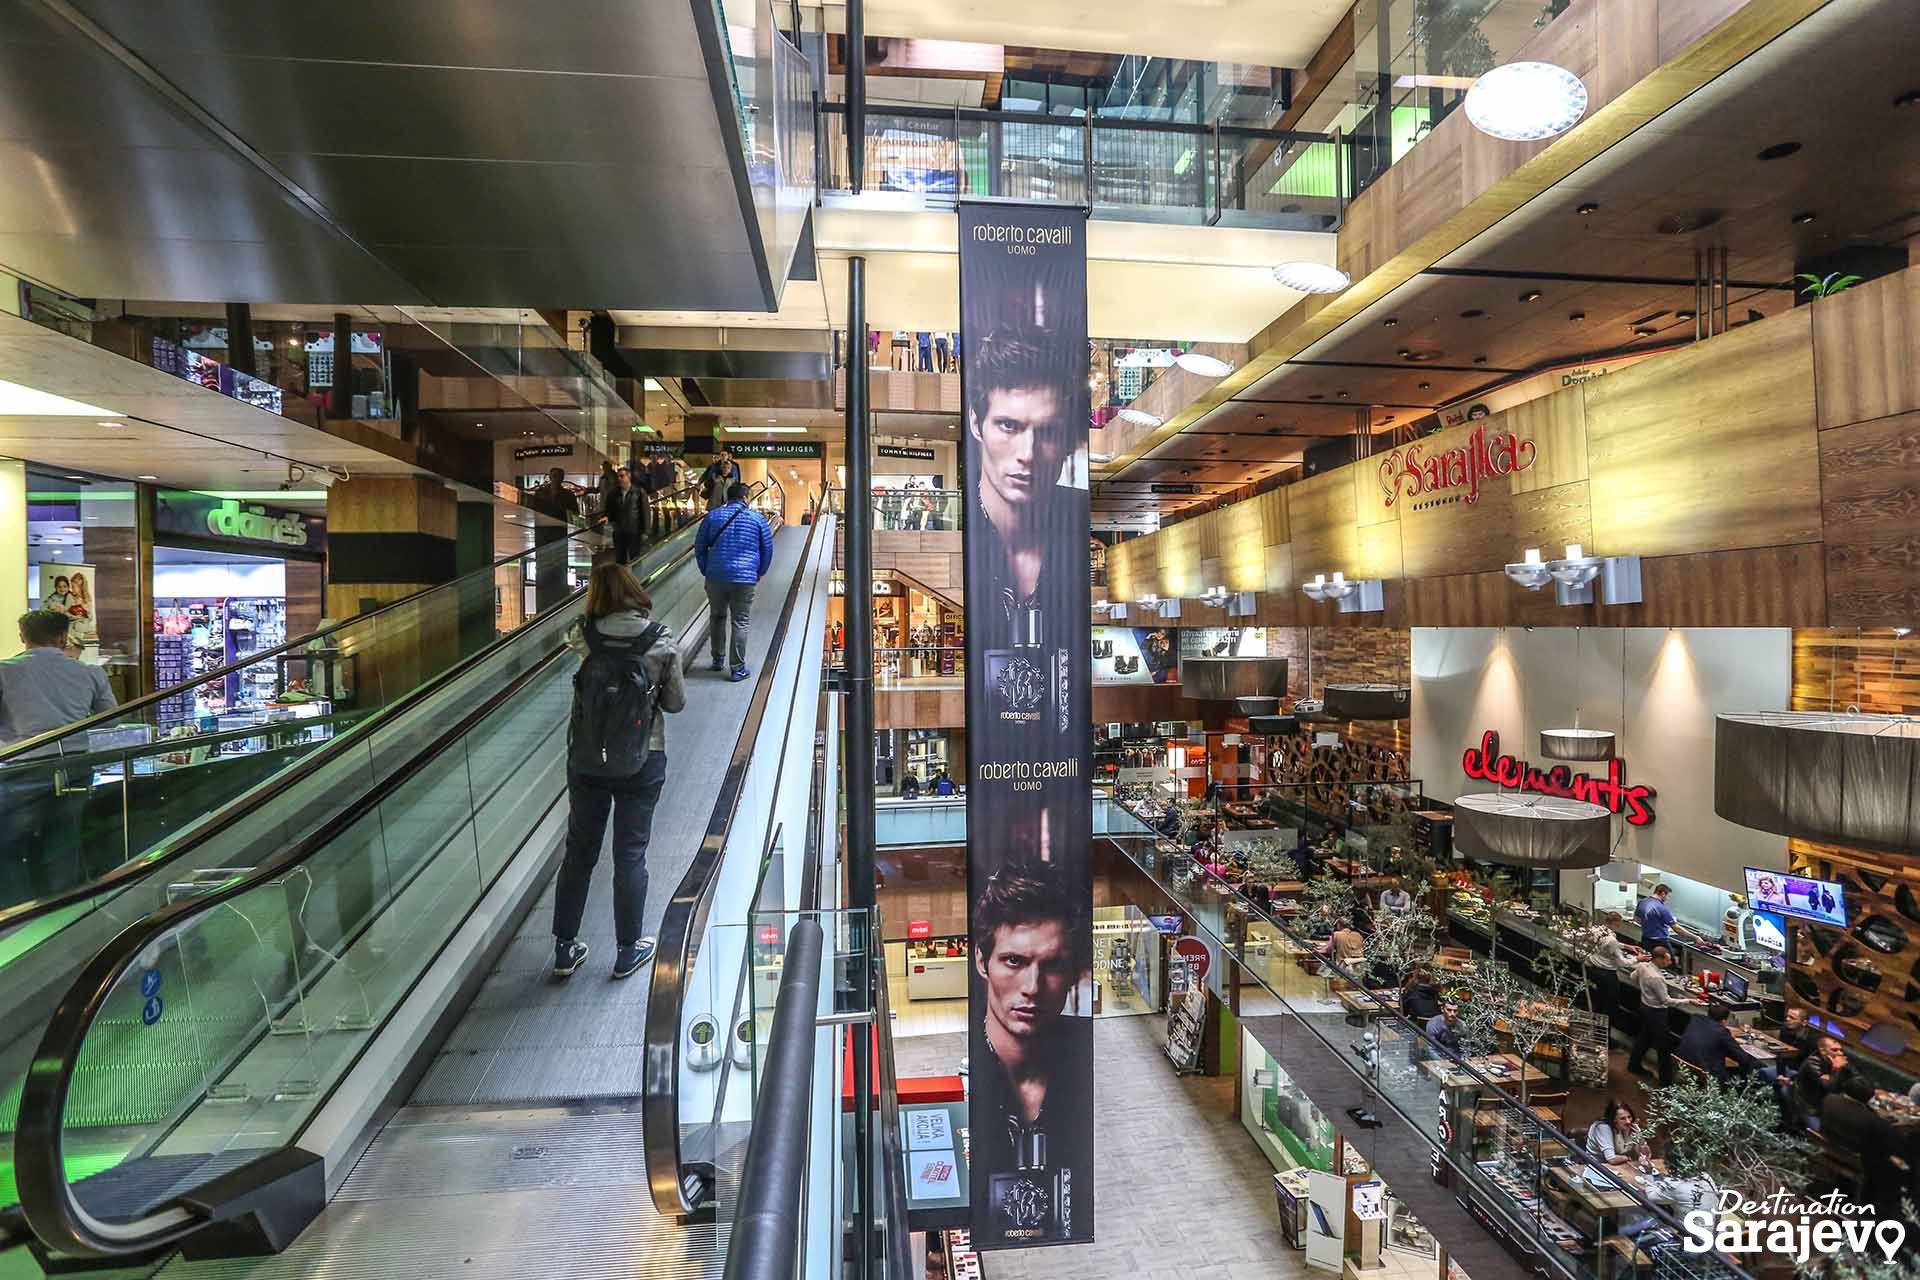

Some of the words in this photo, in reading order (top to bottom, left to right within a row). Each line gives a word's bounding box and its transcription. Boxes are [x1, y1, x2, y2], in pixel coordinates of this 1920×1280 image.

[973, 224, 1024, 242] roberto
[1026, 226, 1072, 244] cavalli
[1007, 245, 1036, 255] UOMO
[979, 760, 1030, 780] roberto
[1033, 758, 1078, 778] cavalli
[1463, 730, 1657, 825] elements
[1013, 781, 1042, 791] UOMO
